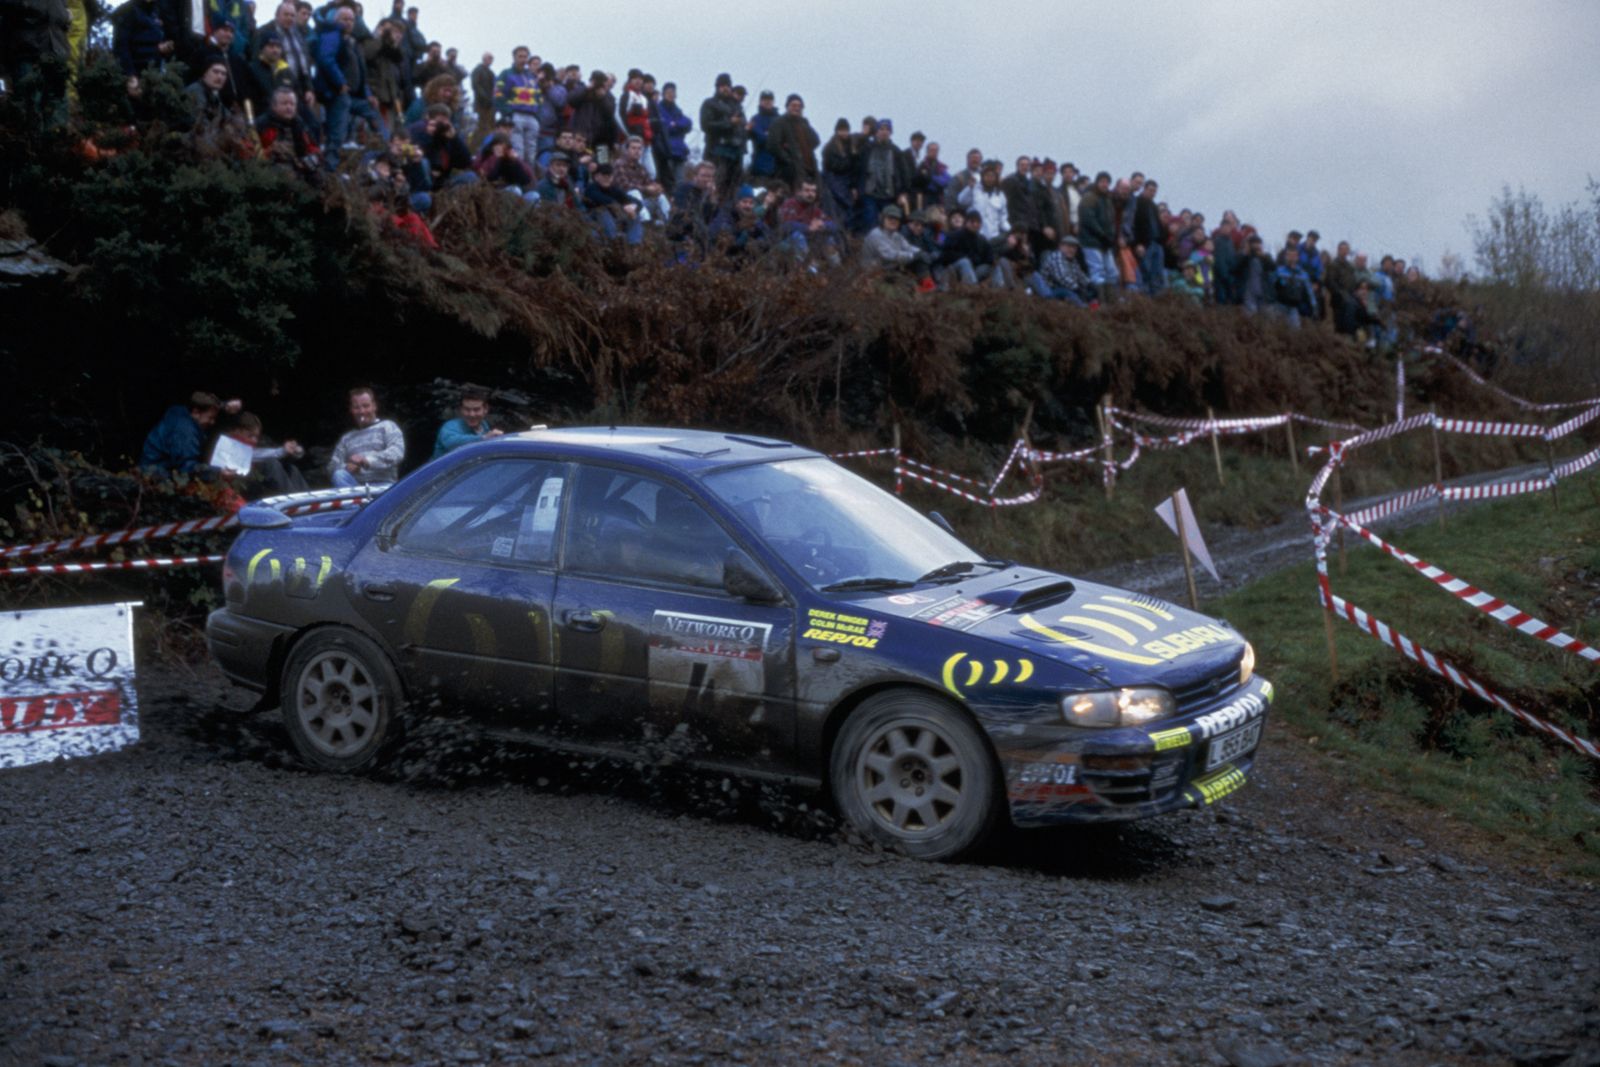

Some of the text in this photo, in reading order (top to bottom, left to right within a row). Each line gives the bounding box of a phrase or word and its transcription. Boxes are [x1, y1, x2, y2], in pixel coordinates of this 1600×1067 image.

[809, 618, 837, 629] COLIN
[802, 628, 879, 648] REPSOL
[1142, 624, 1234, 659] SUBARU
[1194, 693, 1264, 738] REPSOL
